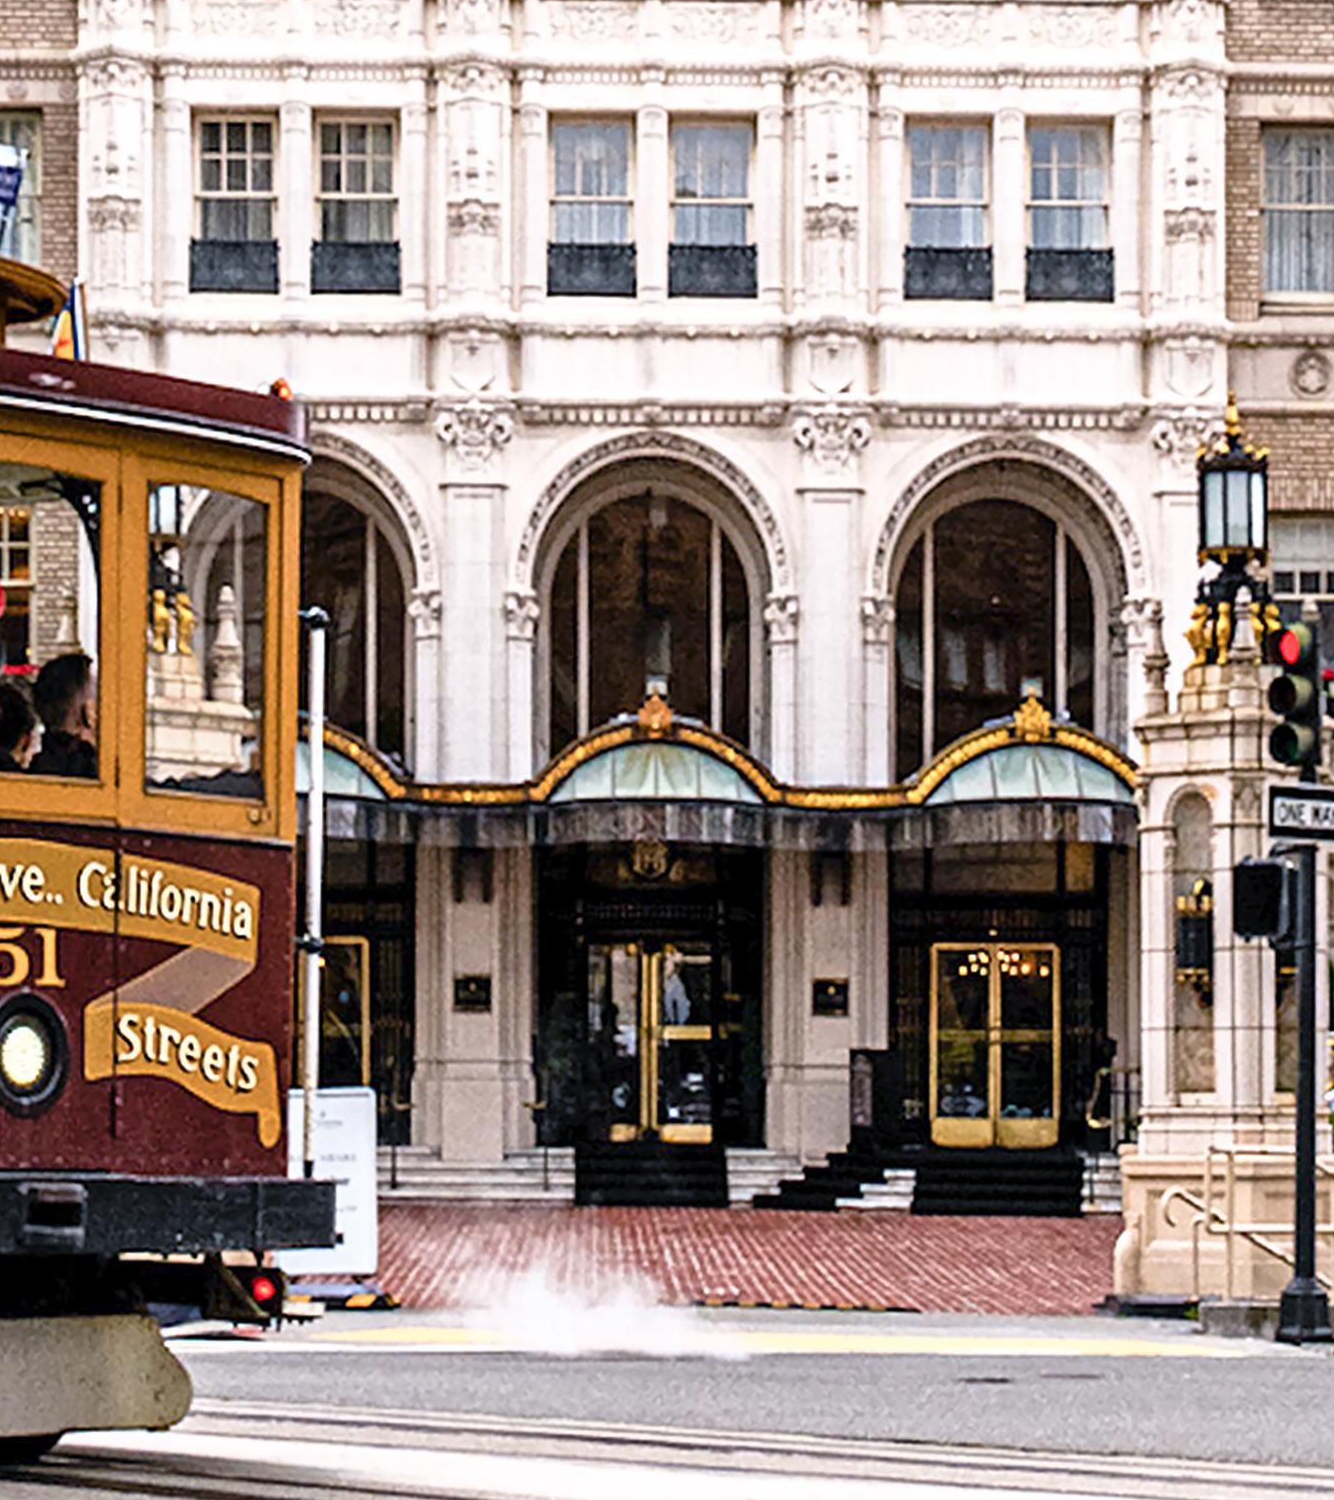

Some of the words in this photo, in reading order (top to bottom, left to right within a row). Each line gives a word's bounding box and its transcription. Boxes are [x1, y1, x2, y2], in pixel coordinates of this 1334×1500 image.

[1278, 802, 1306, 826] ONE
[79, 861, 252, 939] California
[117, 1013, 259, 1091] Streets
